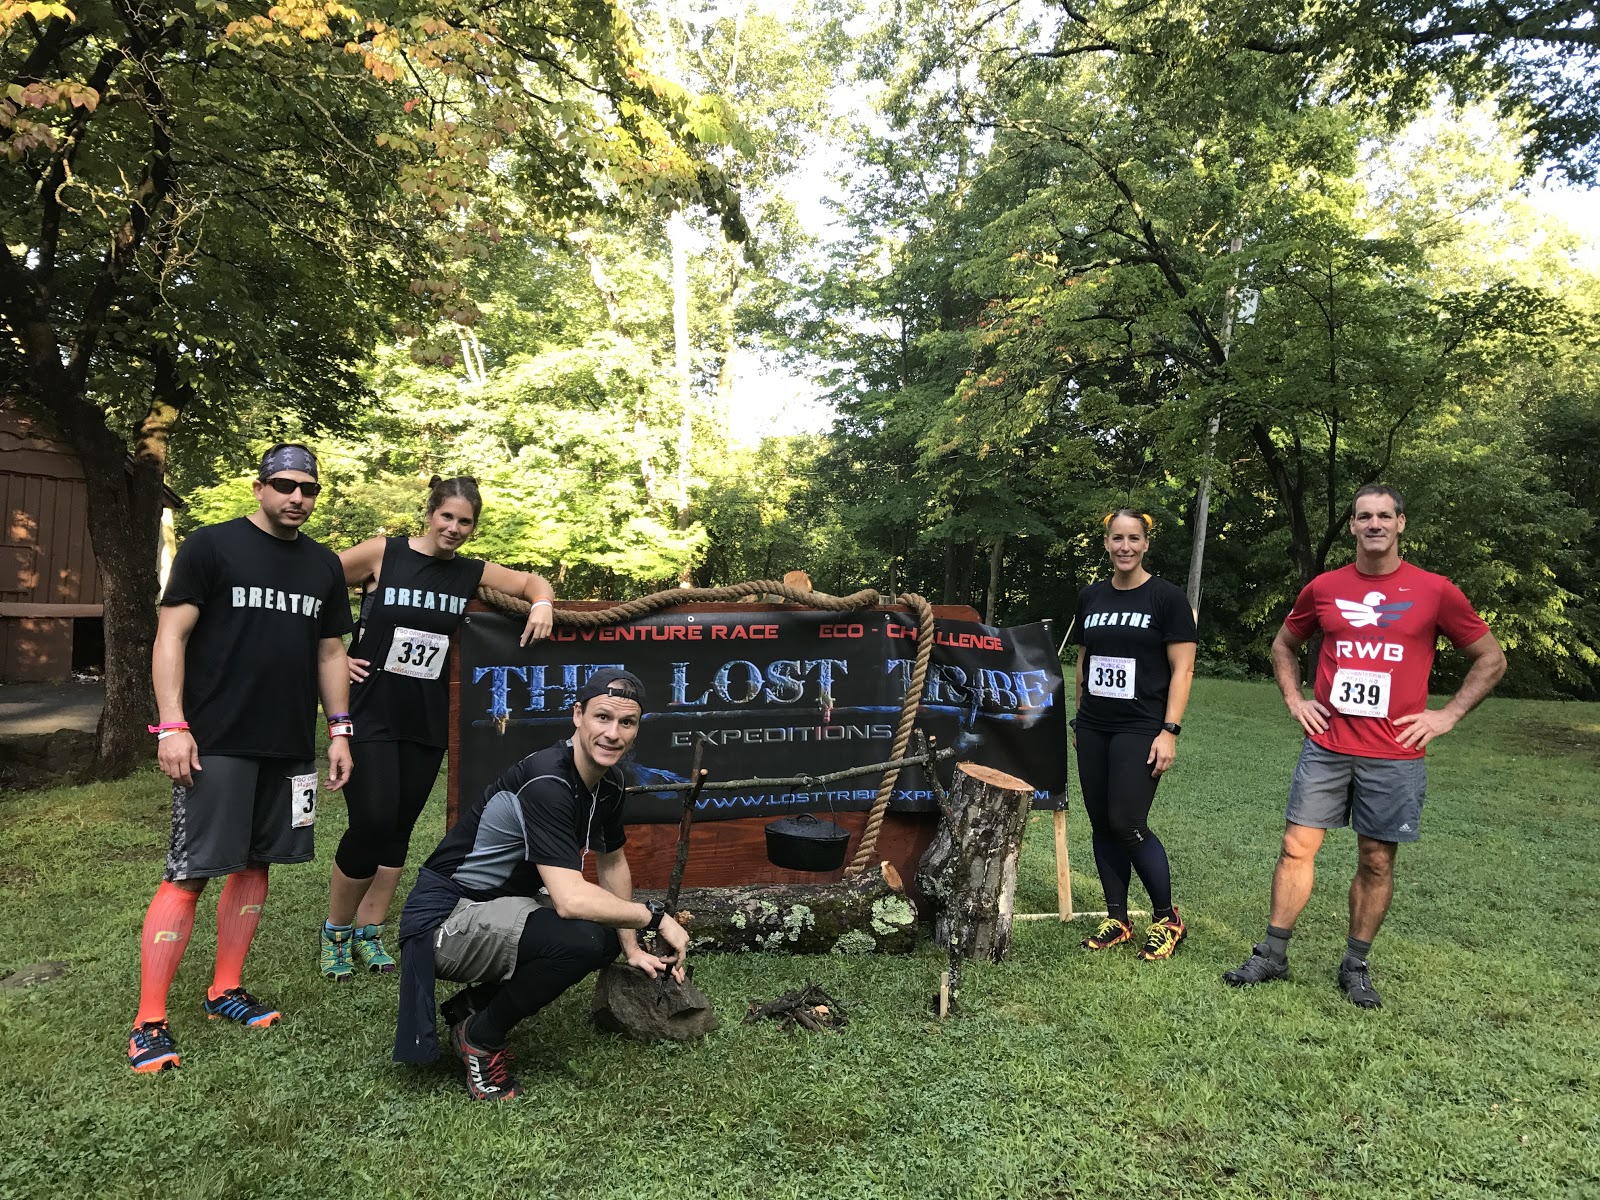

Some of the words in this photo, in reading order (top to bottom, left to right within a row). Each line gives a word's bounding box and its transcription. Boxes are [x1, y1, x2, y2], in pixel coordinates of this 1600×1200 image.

[711, 624, 779, 640] RACE
[819, 623, 864, 638] ECO
[1084, 612, 1151, 630] BREATHE
[398, 642, 440, 668] 337
[1336, 640, 1404, 662] RWB
[666, 659, 849, 706] LOST
[1095, 667, 1127, 689] 338
[1339, 681, 1381, 706] 339
[671, 725, 893, 747] EXPEDITIONS
